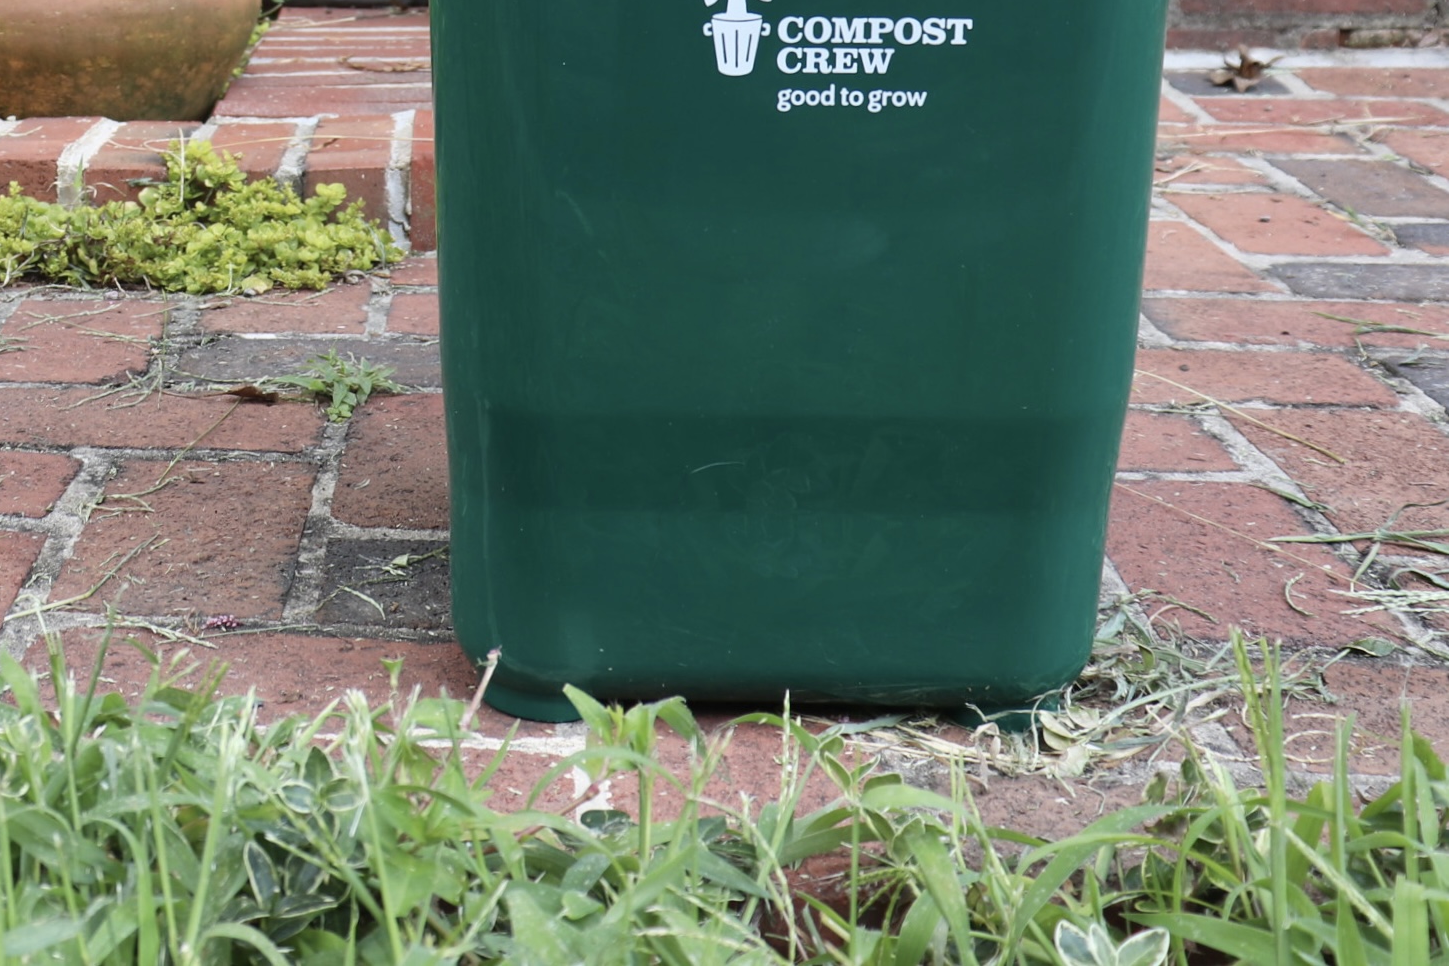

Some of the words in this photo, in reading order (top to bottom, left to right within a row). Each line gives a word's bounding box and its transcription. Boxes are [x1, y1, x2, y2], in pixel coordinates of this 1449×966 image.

[777, 16, 974, 46] COMPOST
[776, 47, 895, 75] CREW
[777, 83, 836, 113] good
[840, 87, 864, 107] to
[867, 90, 928, 113] grow
